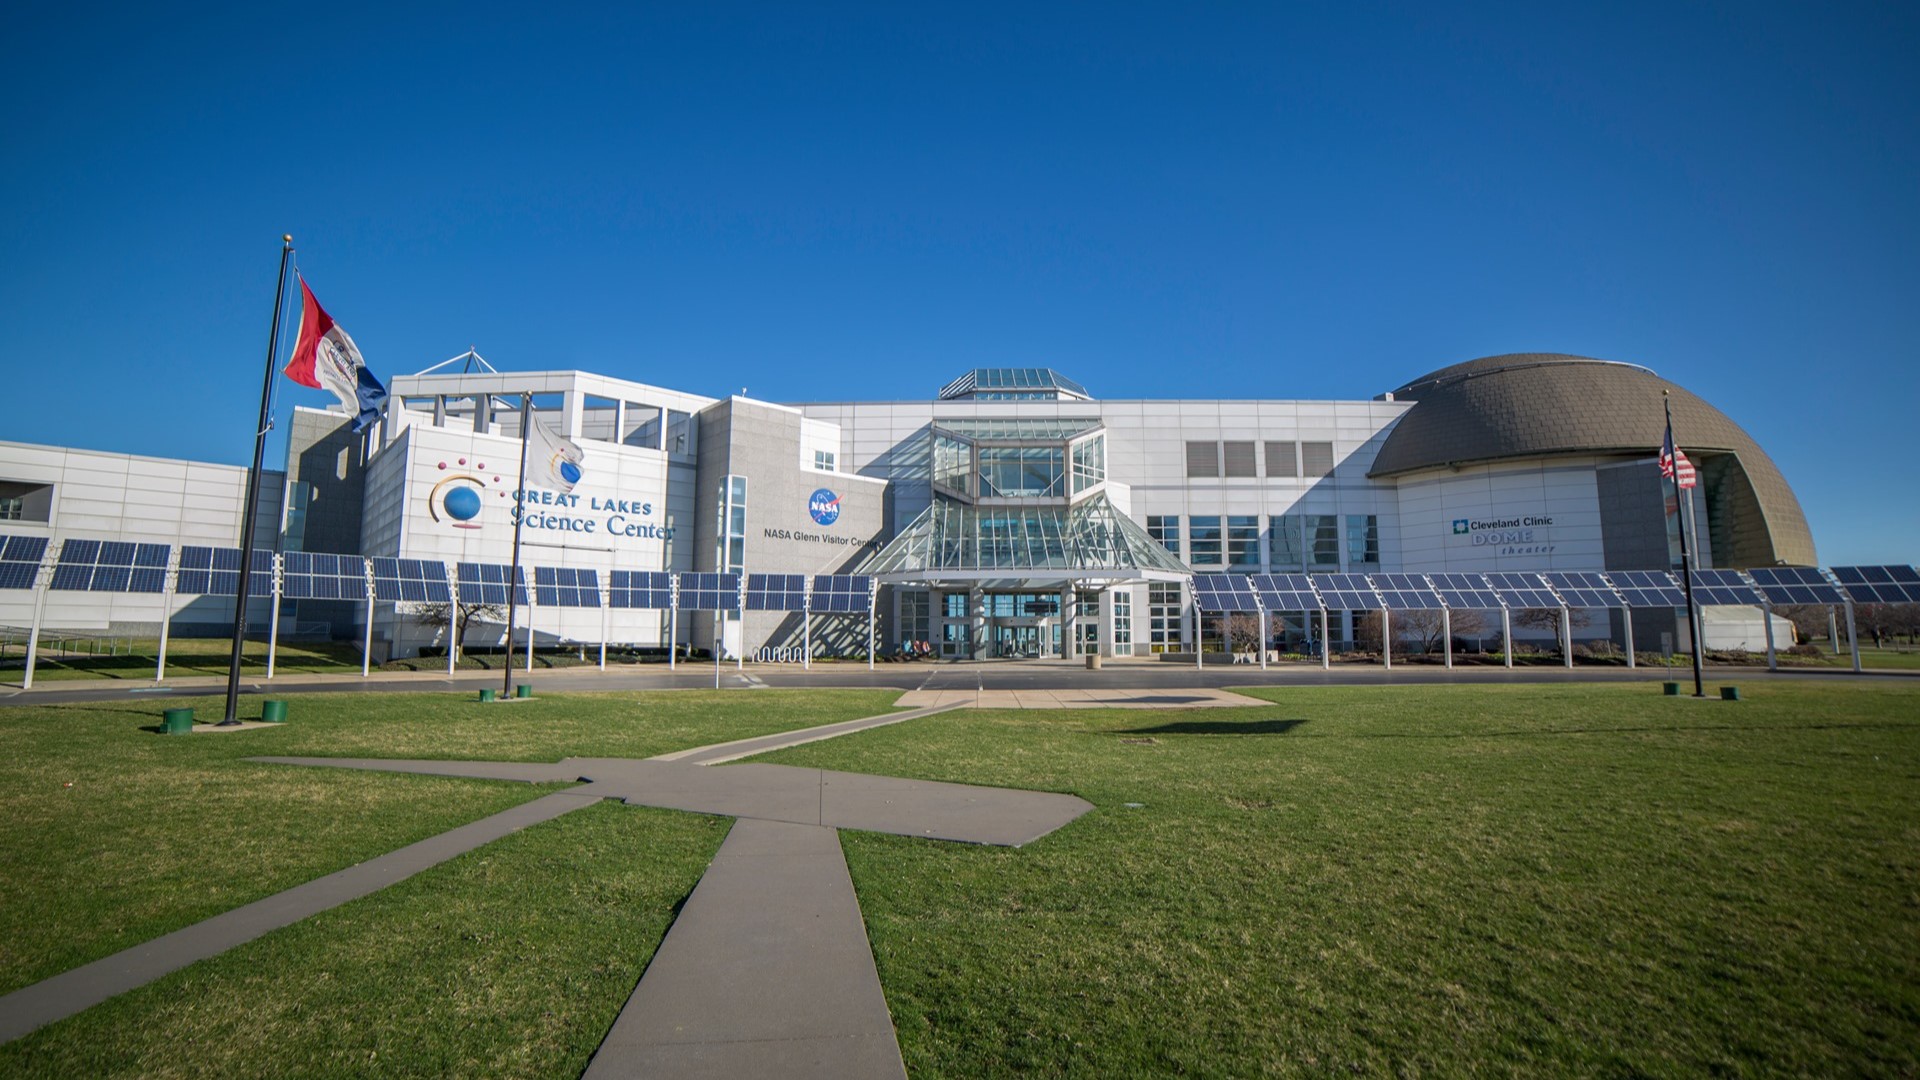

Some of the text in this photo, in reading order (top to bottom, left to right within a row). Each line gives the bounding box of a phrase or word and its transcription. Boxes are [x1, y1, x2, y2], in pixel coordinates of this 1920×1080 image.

[591, 496, 652, 515] LAKES
[811, 502, 838, 513] NASA
[511, 505, 676, 540] Science Center
[1471, 516, 1553, 530] Cleveland Clinic
[764, 528, 878, 548] NASA Glenn Visitor Center
[1471, 530, 1535, 547] DOME
[1502, 545, 1555, 555] theater
